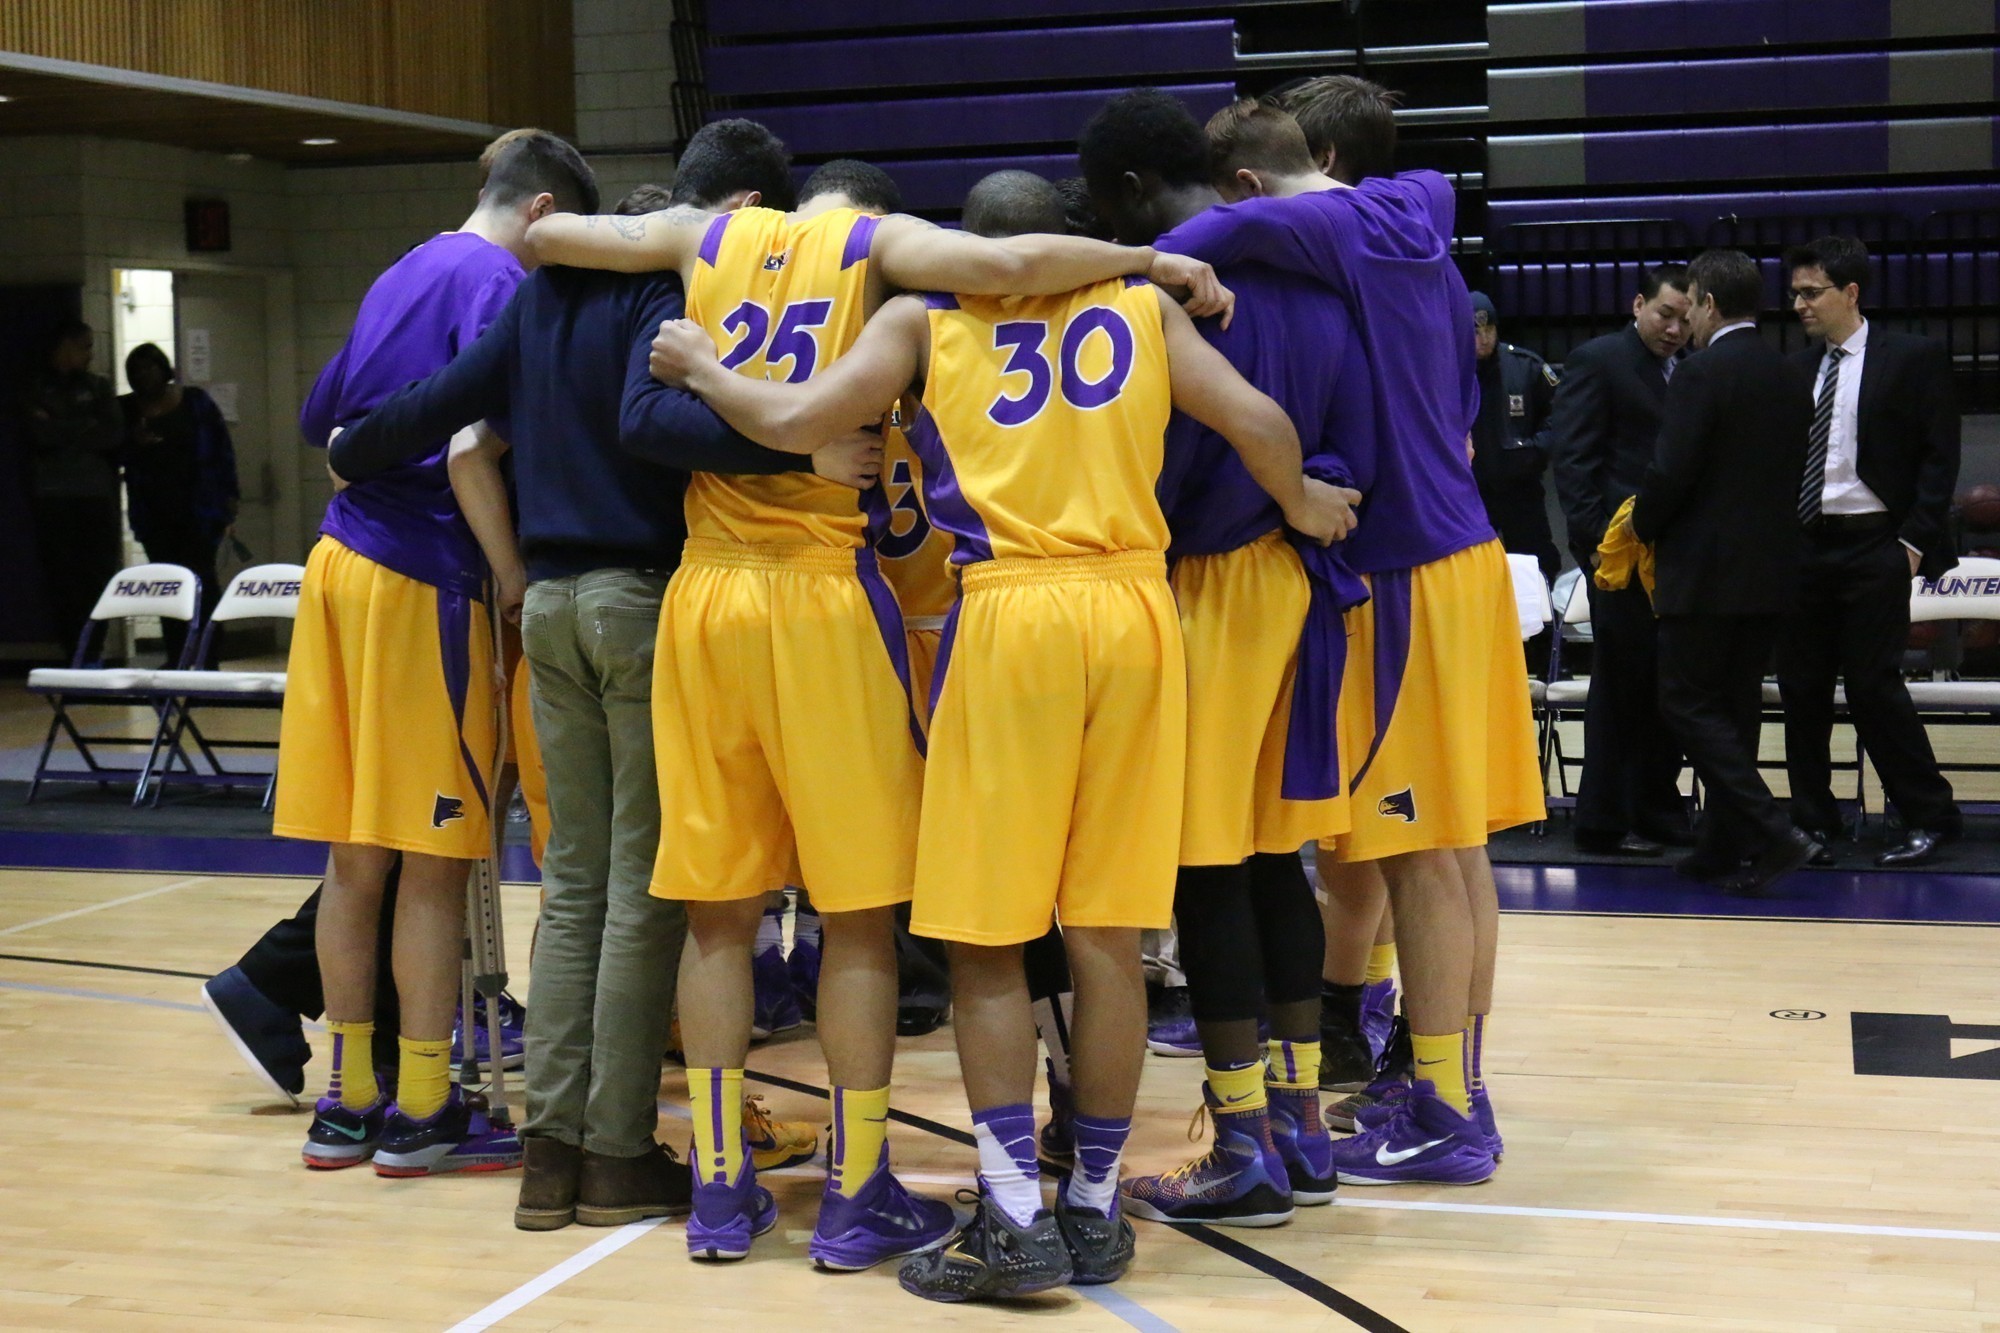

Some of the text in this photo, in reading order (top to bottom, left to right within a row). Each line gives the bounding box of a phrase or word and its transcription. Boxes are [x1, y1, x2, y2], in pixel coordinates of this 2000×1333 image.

[719, 298, 834, 384] 25
[986, 305, 1136, 429] 30
[114, 580, 182, 597] HUNTER
